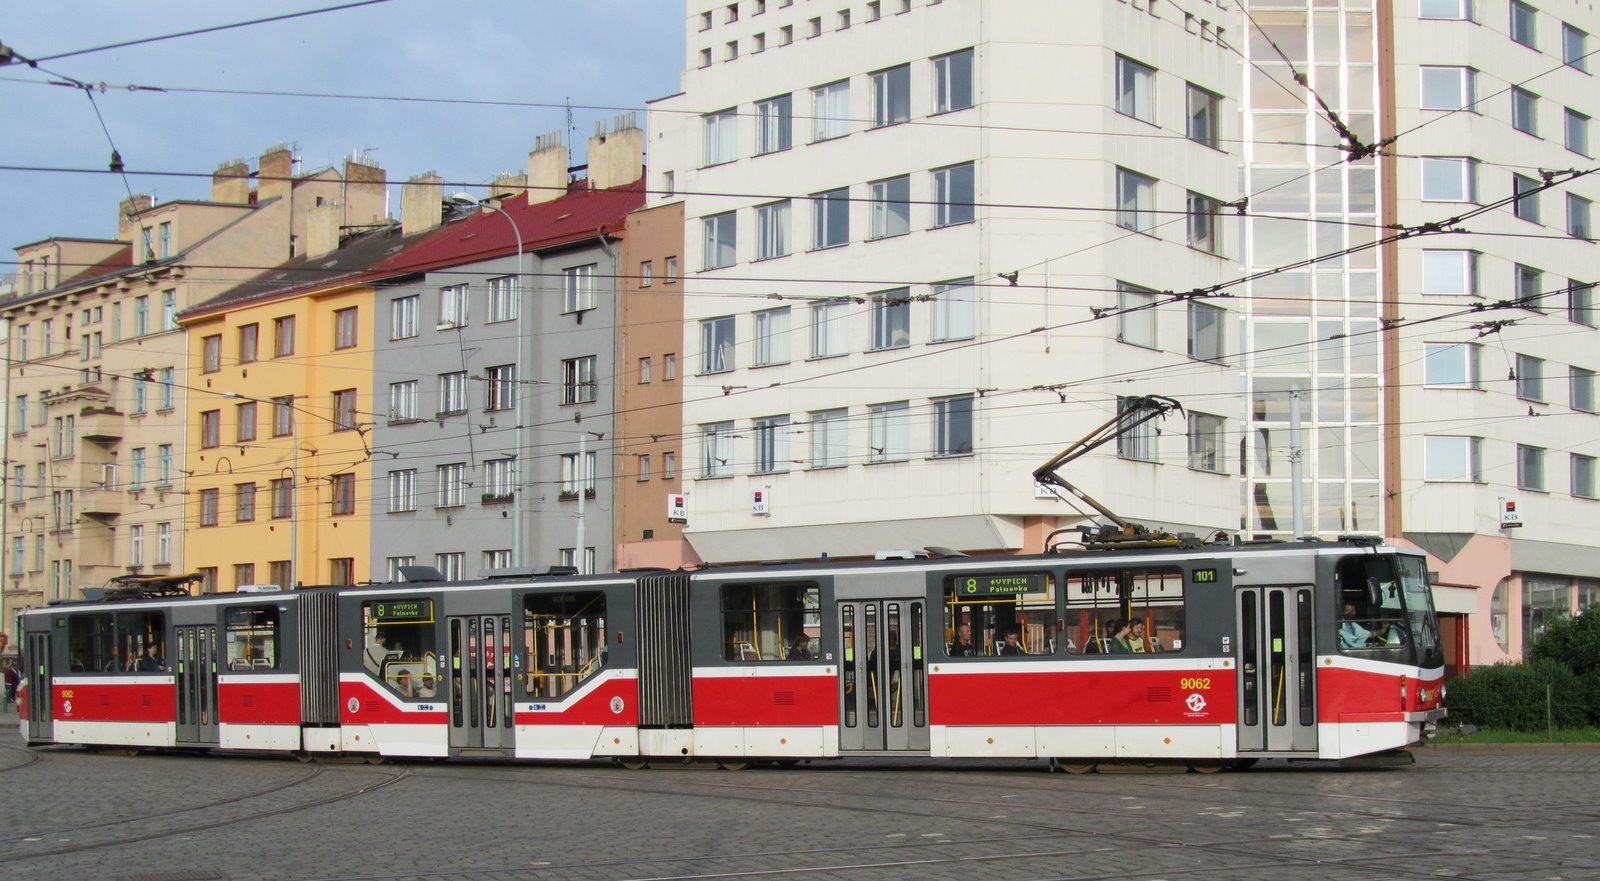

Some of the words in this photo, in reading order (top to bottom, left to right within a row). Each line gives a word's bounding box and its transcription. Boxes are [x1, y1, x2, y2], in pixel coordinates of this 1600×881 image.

[1504, 513, 1518, 521] KB
[995, 577, 1027, 585] VYPICH
[1196, 570, 1213, 582] 101
[966, 578, 977, 593] 8
[989, 585, 1028, 593] Palmovka
[377, 604, 385, 617] 8
[1180, 677, 1211, 690] 9062
